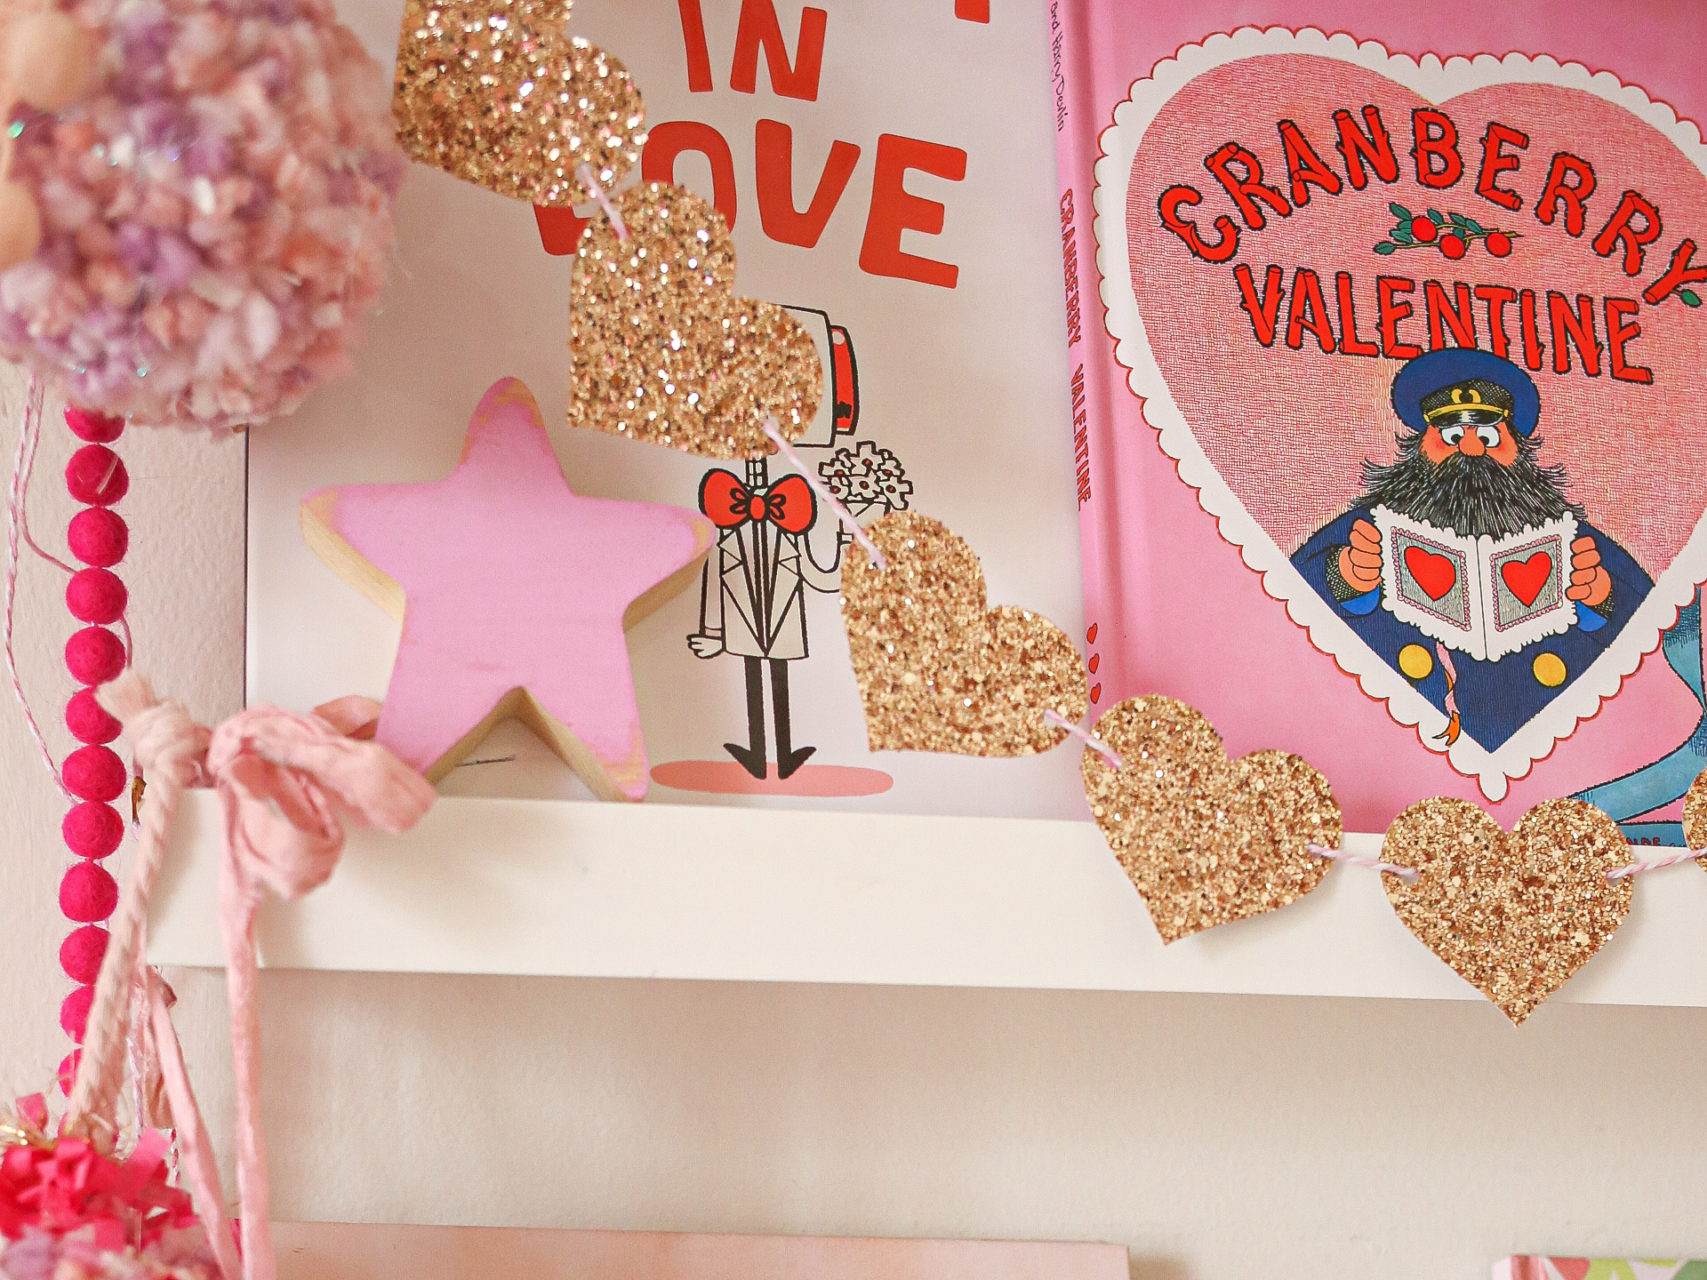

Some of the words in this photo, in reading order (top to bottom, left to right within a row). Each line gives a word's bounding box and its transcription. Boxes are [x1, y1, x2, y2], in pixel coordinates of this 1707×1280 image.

[677, 0, 828, 101] IN
[534, 118, 967, 289] OVE
[1157, 105, 1706, 304] CRANBERRY
[1060, 188, 1081, 348] CRANBERRY
[1071, 363, 1091, 512] VALENTINE
[1233, 264, 1652, 385] VALENTINE
